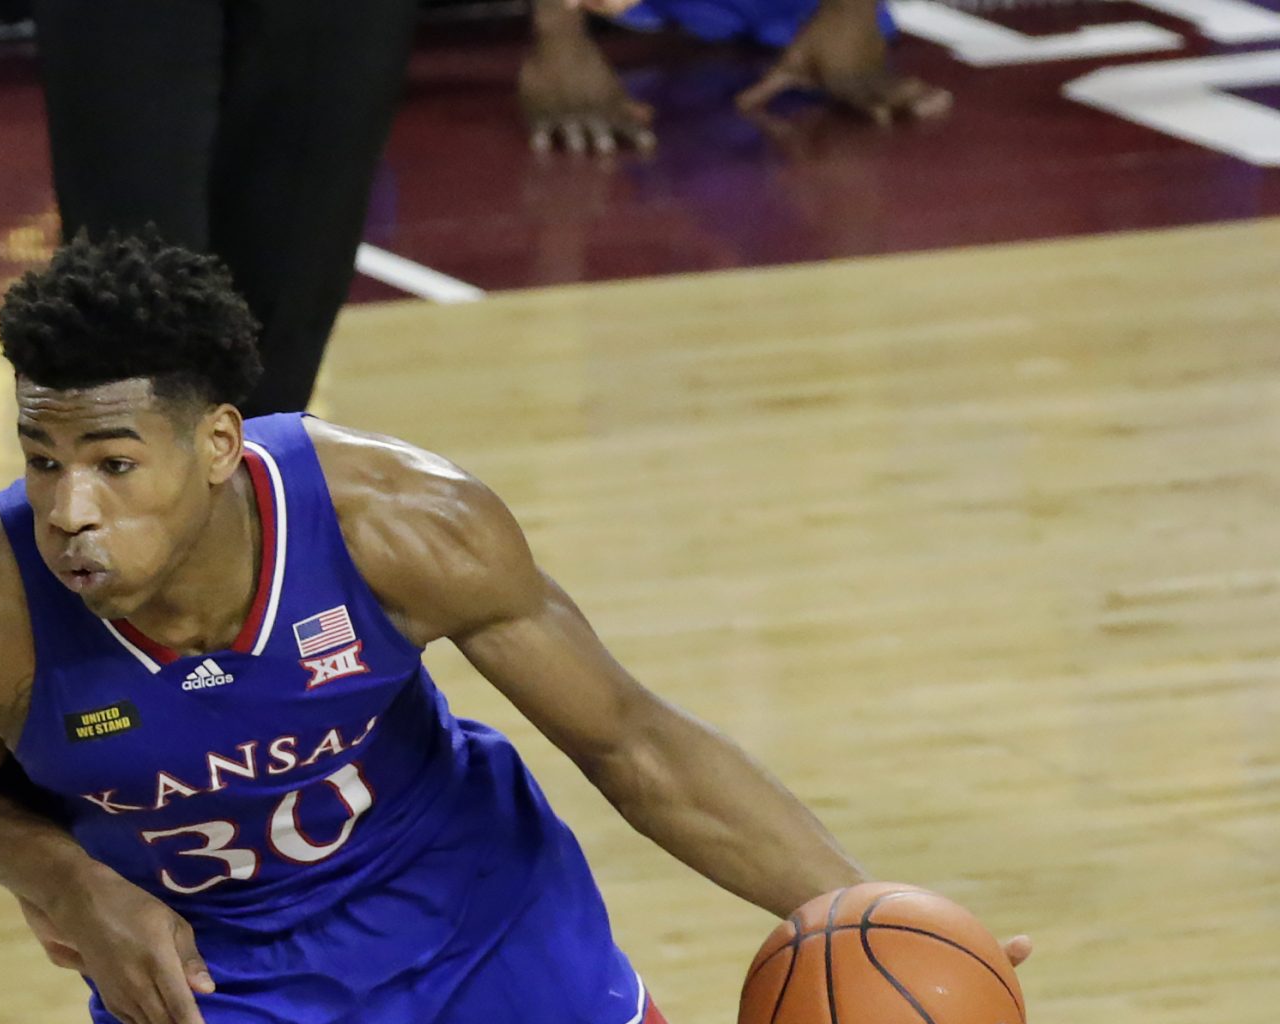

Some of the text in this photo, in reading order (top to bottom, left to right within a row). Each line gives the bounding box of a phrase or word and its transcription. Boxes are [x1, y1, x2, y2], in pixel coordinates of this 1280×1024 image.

[300, 641, 370, 690] XII
[181, 674, 234, 691] adidas
[75, 716, 131, 738] WE STAND
[81, 707, 120, 726] UNITED
[139, 761, 373, 895] 30
